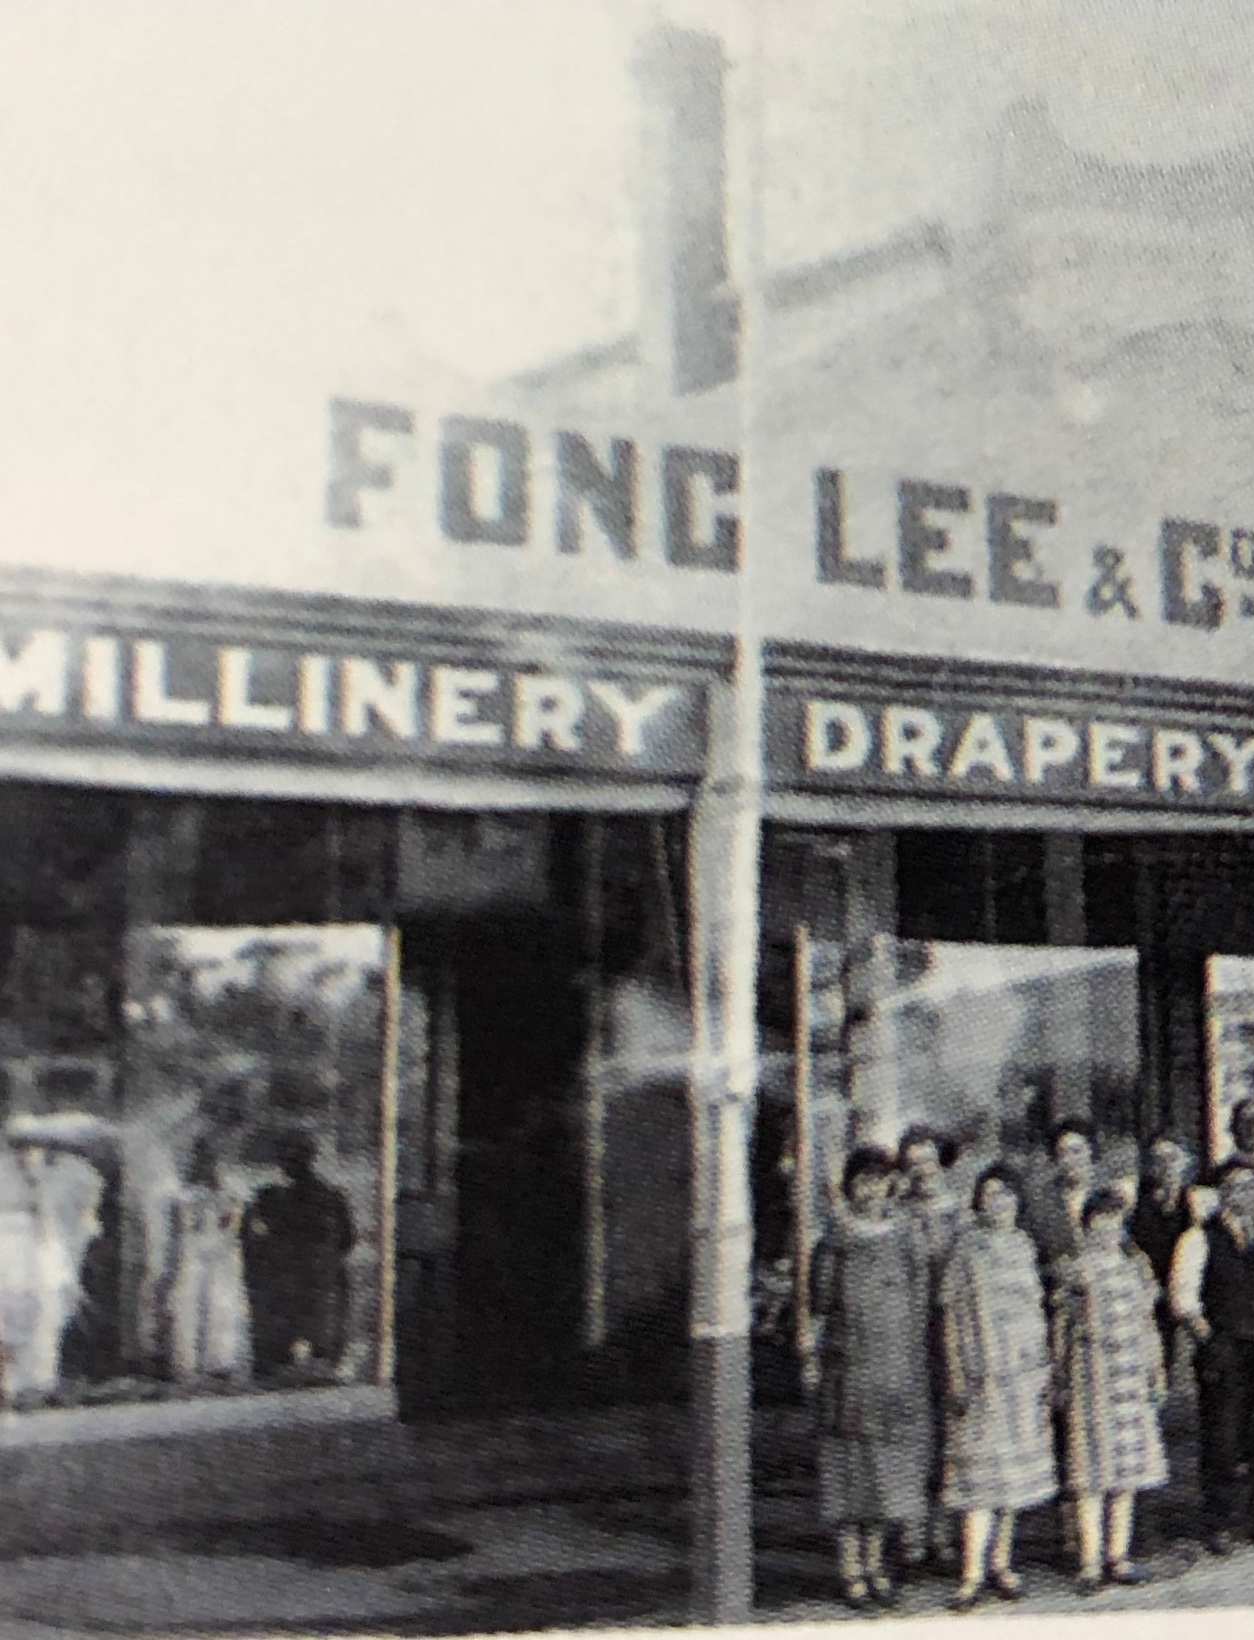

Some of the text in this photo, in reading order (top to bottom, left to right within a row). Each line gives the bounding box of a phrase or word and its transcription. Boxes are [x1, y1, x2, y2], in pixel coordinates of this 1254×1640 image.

[325, 397, 743, 574] FONG
[814, 466, 1063, 610] LEE
[1084, 545, 1140, 621] &
[0, 628, 684, 756] MILLINERY
